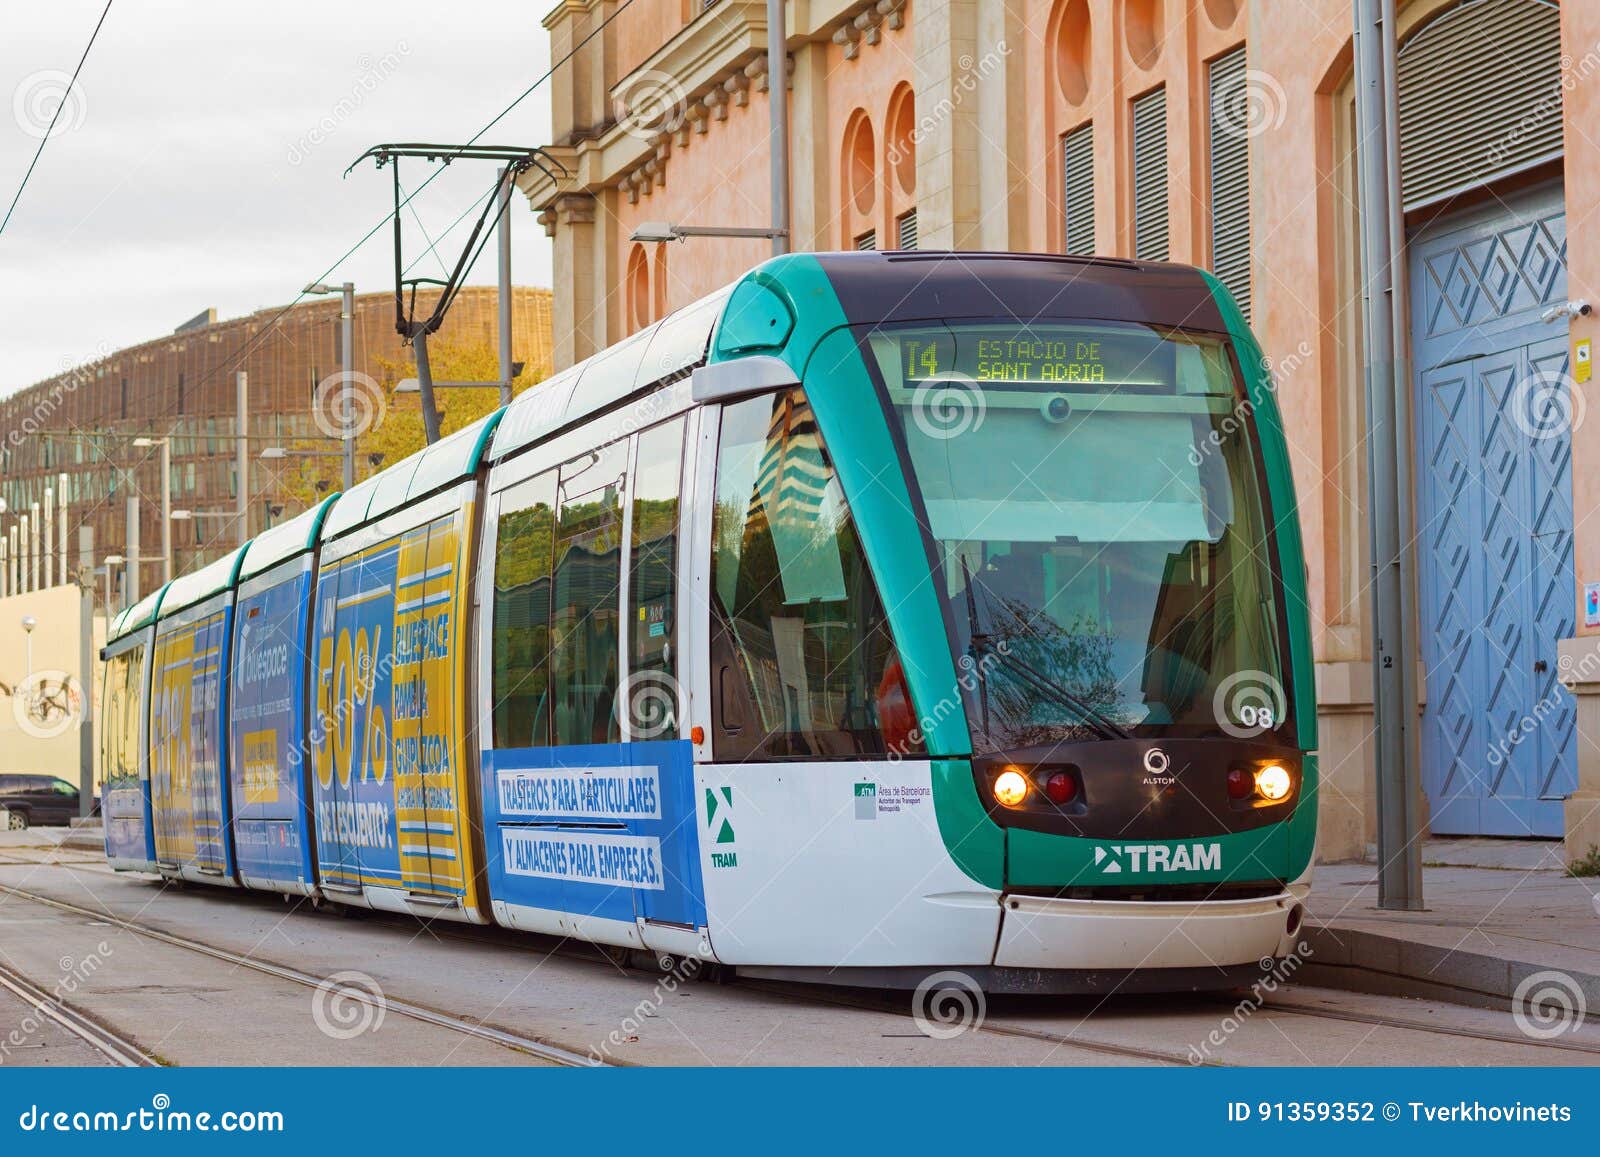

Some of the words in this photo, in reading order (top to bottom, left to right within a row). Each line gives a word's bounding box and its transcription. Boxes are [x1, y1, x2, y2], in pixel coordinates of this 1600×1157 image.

[906, 341, 938, 377] T4
[976, 340, 1066, 360] ESTACIO
[1076, 342, 1101, 361] DE
[976, 362, 1033, 381] SANT
[1041, 363, 1105, 382] ADRIA
[315, 624, 388, 790] 50%
[1240, 705, 1274, 729] 08
[501, 777, 550, 811] TRASTEROS
[551, 777, 578, 811] PARA
[580, 776, 656, 814] PARTICULARES
[505, 838, 514, 868] Y
[516, 839, 567, 874] ALMACENES
[569, 842, 597, 877] PARA
[598, 844, 660, 884] EMPRESAS.
[711, 852, 738, 868] TRAM
[1124, 843, 1222, 873] TRAM
